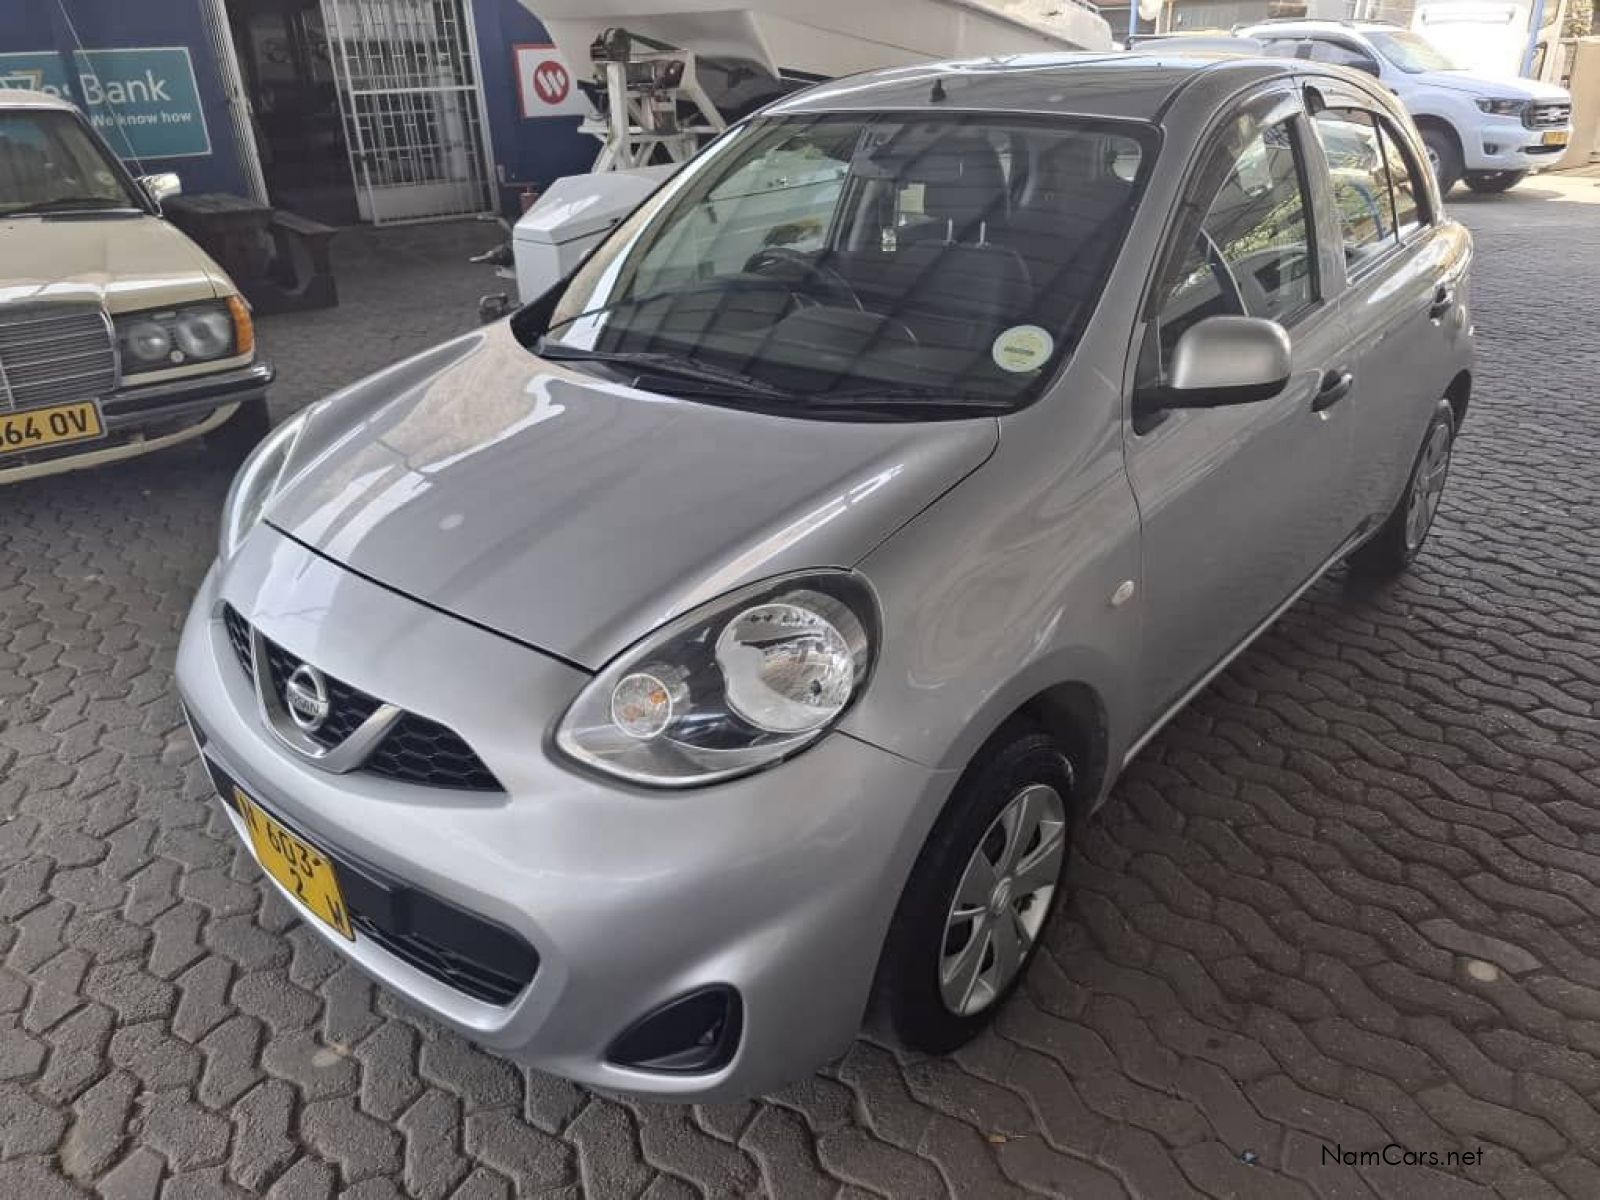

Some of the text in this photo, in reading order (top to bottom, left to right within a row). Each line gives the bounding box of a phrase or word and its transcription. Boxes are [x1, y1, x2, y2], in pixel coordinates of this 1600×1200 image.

[160, 110, 192, 124] how
[0, 407, 87, 447] 64 OV
